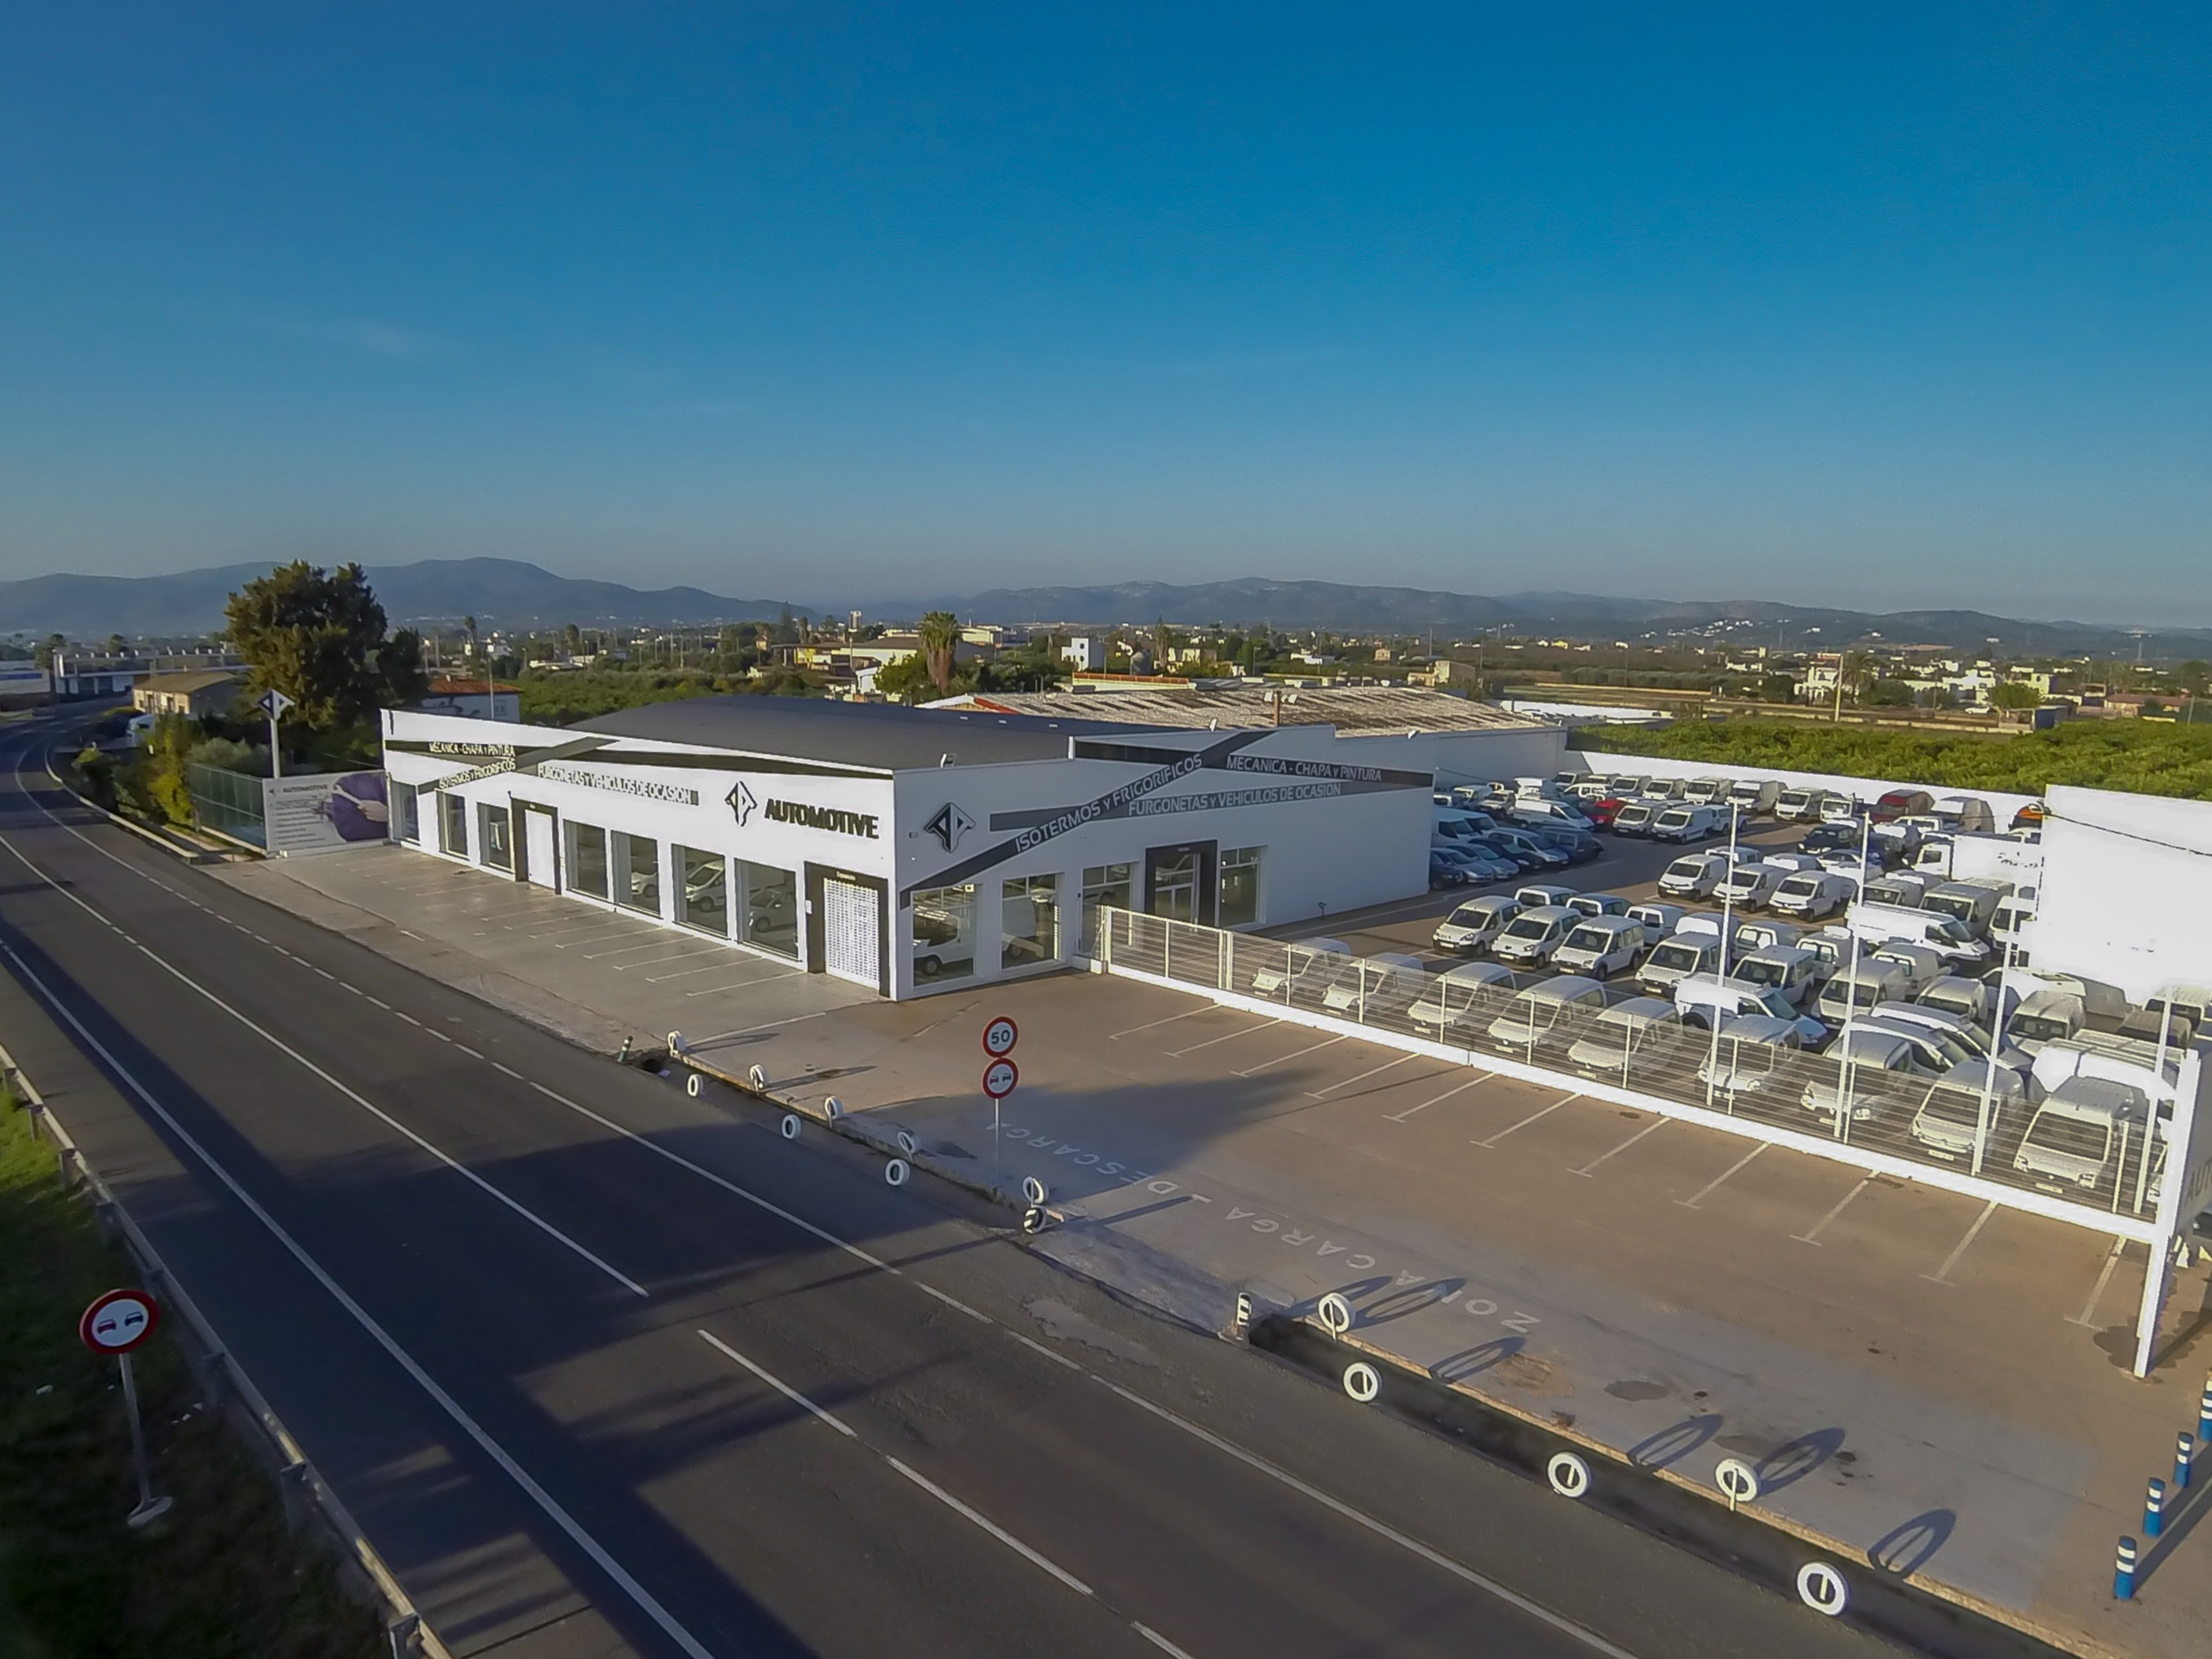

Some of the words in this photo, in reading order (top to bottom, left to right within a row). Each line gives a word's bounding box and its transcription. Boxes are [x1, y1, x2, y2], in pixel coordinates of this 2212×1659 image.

[1226, 754, 1287, 774] MECANICA
[1296, 761, 1332, 778] CHAPA
[1340, 767, 1382, 782] PINTURA
[636, 781, 649, 796] DE
[1015, 801, 1102, 853] ISOTERMOS
[1112, 753, 1203, 806] FRIGORIFICOS
[1128, 795, 1208, 815] FURGONETAS
[1218, 790, 1278, 806] VEHICULOS
[1280, 787, 1294, 800] DE
[1296, 783, 1341, 798] OCASION
[764, 798, 880, 839] AUTOMOTIVE
[991, 1030, 1010, 1045] 50
[986, 1122, 1181, 1195] DESCARGA
[1225, 1206, 1376, 1271] CARGA
